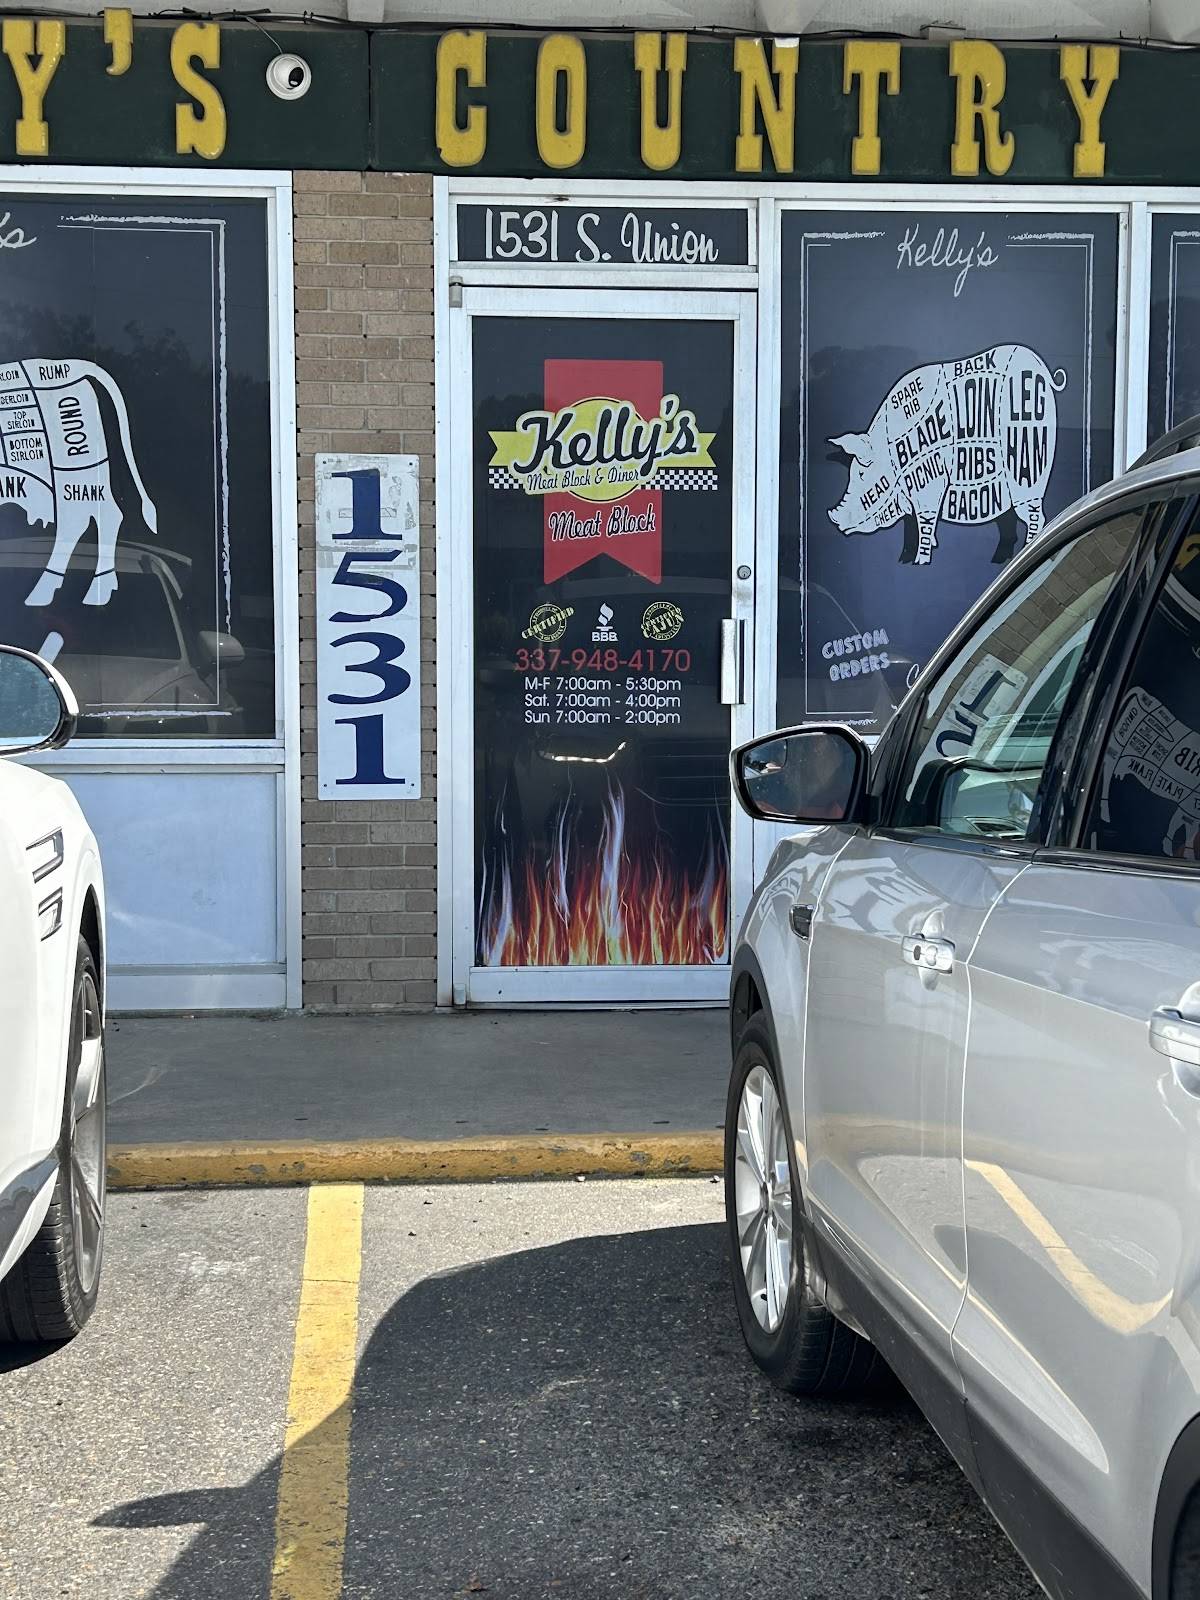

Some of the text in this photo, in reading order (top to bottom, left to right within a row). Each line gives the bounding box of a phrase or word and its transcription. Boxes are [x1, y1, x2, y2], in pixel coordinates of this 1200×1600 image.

[435, 29, 1120, 178] COUNTRY
[486, 208, 719, 264] 1531 S. Union
[897, 223, 999, 297] Kelly's
[39, 363, 70, 381] RUMP
[954, 350, 998, 377] BACK
[891, 377, 924, 410] SPARE
[904, 398, 921, 419] RIB
[953, 377, 998, 439] LOIN
[1009, 370, 1046, 421] LEG
[7, 419, 35, 430] SIRLOIN
[13, 411, 27, 420] TOP
[58, 396, 90, 457] ROUND
[9, 438, 43, 450] BOTTOM
[511, 397, 699, 477] Kelly's
[895, 400, 951, 468] BLADE
[11, 449, 44, 462] SIRLOIN
[957, 447, 996, 481] RIBS
[1006, 426, 1048, 488] HAM
[527, 465, 641, 491] Meat Block & Diner
[905, 452, 946, 497] PICNIC
[64, 484, 105, 501] SHANK
[860, 476, 891, 511] HEAD
[948, 482, 1003, 520] BACON
[549, 503, 656, 541] Meat Block
[874, 496, 904, 526] CHEEK
[920, 515, 936, 555] HOCK
[328, 468, 411, 785] 1531
[592, 631, 618, 642] BBB
[821, 628, 890, 660] CUSTOM
[515, 649, 691, 672] 337-948-4170
[829, 652, 891, 682] ORDERS
[524, 677, 550, 690] M-F
[556, 677, 611, 691] 7:00am
[625, 677, 681, 693] 5:30pm
[524, 694, 549, 707] Sat.
[556, 694, 611, 707] 7:00am
[625, 694, 681, 709] 4:00pm
[524, 710, 550, 724] Sun
[556, 710, 611, 724] 7:00am
[625, 711, 681, 726] 2:00pm
